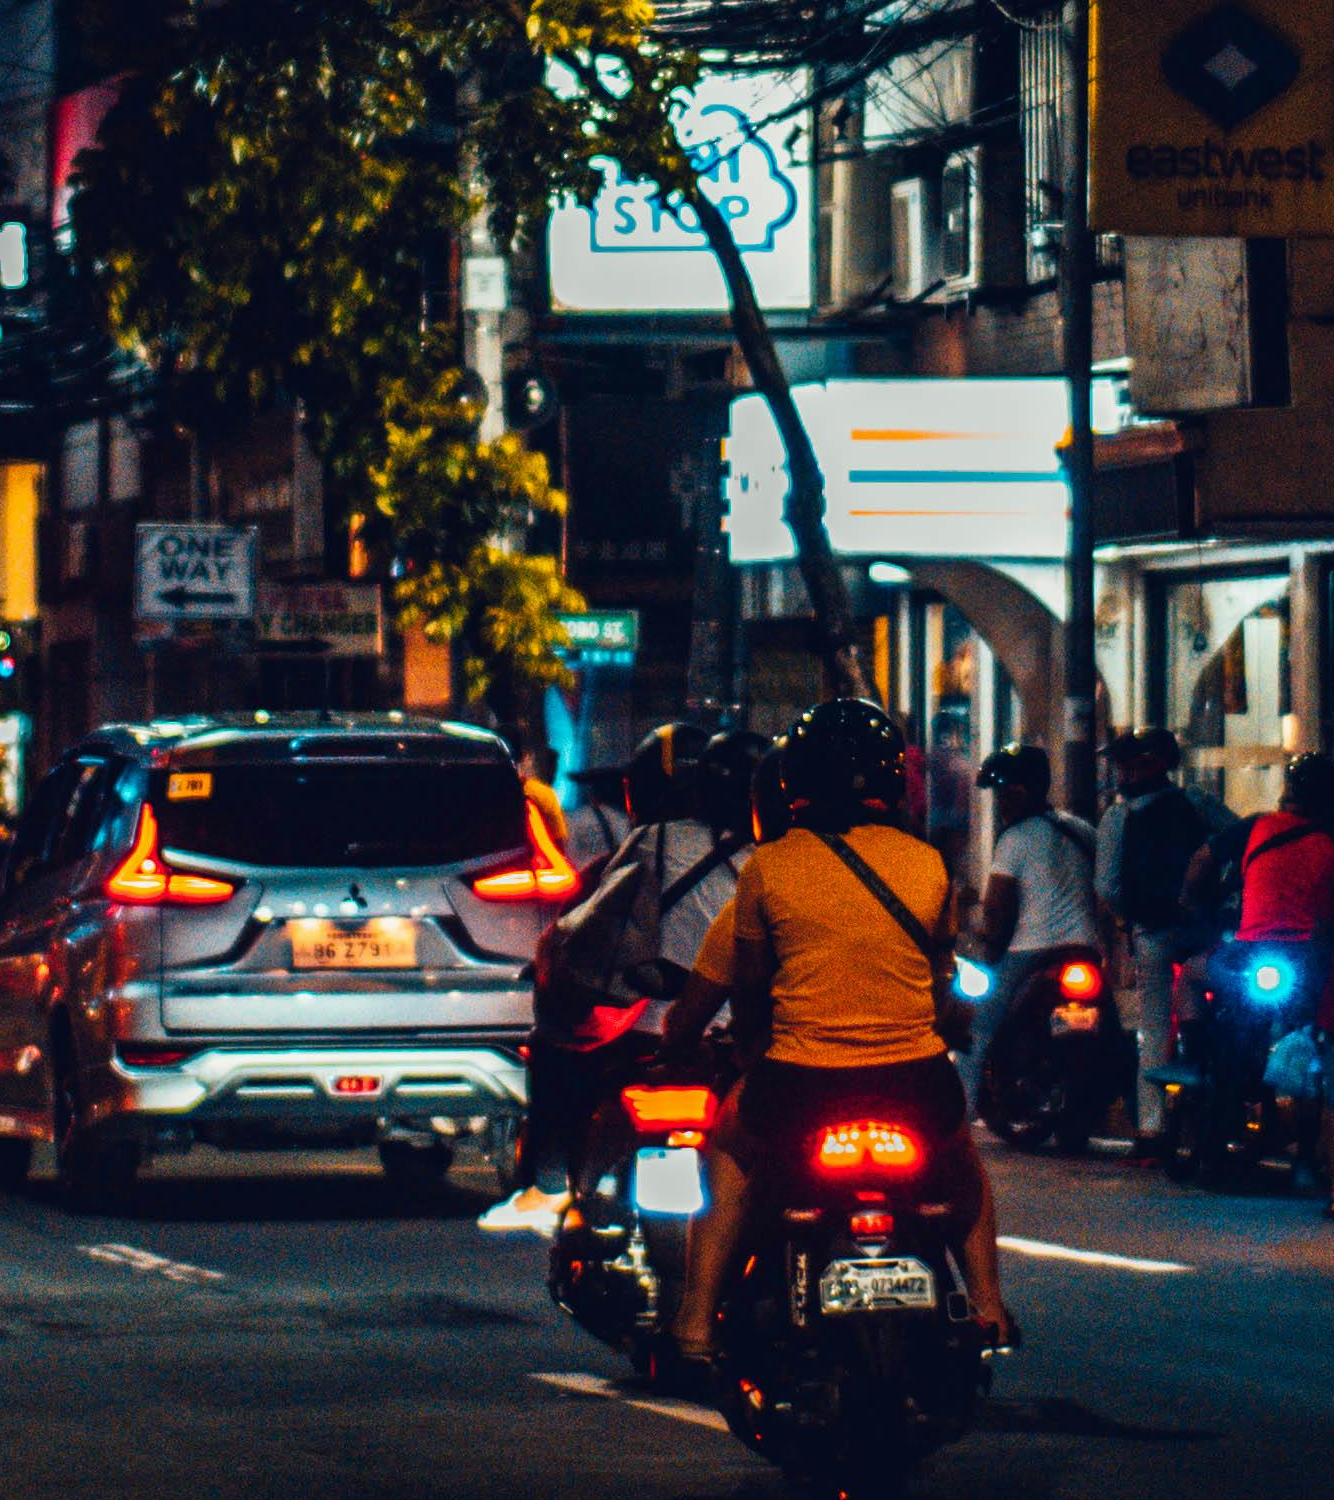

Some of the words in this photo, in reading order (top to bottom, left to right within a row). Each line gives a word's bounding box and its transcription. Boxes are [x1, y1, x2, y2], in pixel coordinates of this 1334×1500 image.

[1126, 138, 1325, 182] eastwest
[157, 534, 235, 558] ONE
[159, 559, 231, 582] WAY
